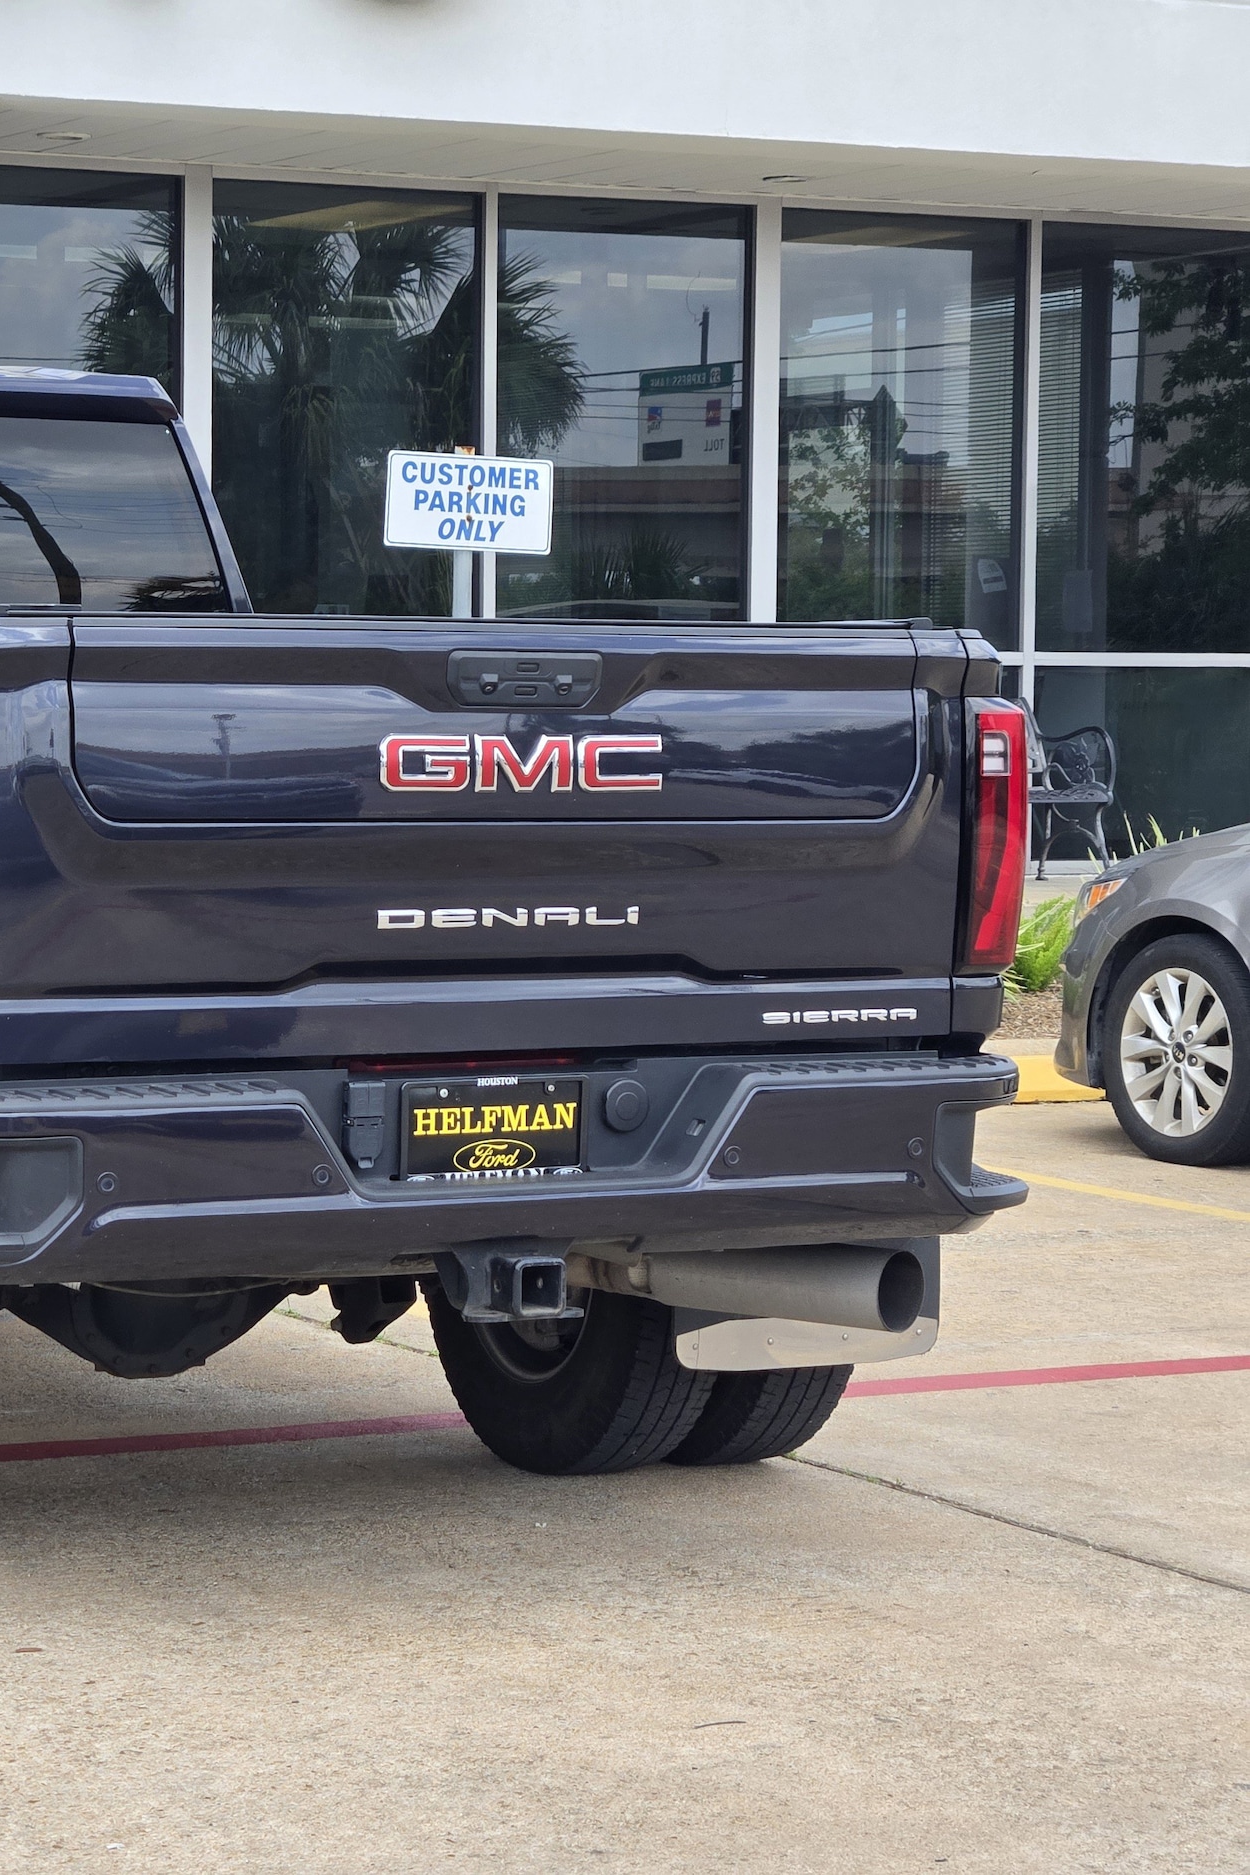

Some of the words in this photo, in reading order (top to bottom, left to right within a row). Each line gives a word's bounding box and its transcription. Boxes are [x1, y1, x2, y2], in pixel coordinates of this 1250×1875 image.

[401, 461, 539, 490] CUSTOMER
[413, 489, 526, 517] PARKING
[437, 517, 505, 543] ONLY
[379, 733, 662, 793] GMC
[376, 906, 640, 930] DENALI
[762, 1007, 918, 1025] SIERRA
[476, 1077, 519, 1087] HOUSTON
[413, 1102, 578, 1136] HELFMAN
[468, 1143, 521, 1168] Ford
